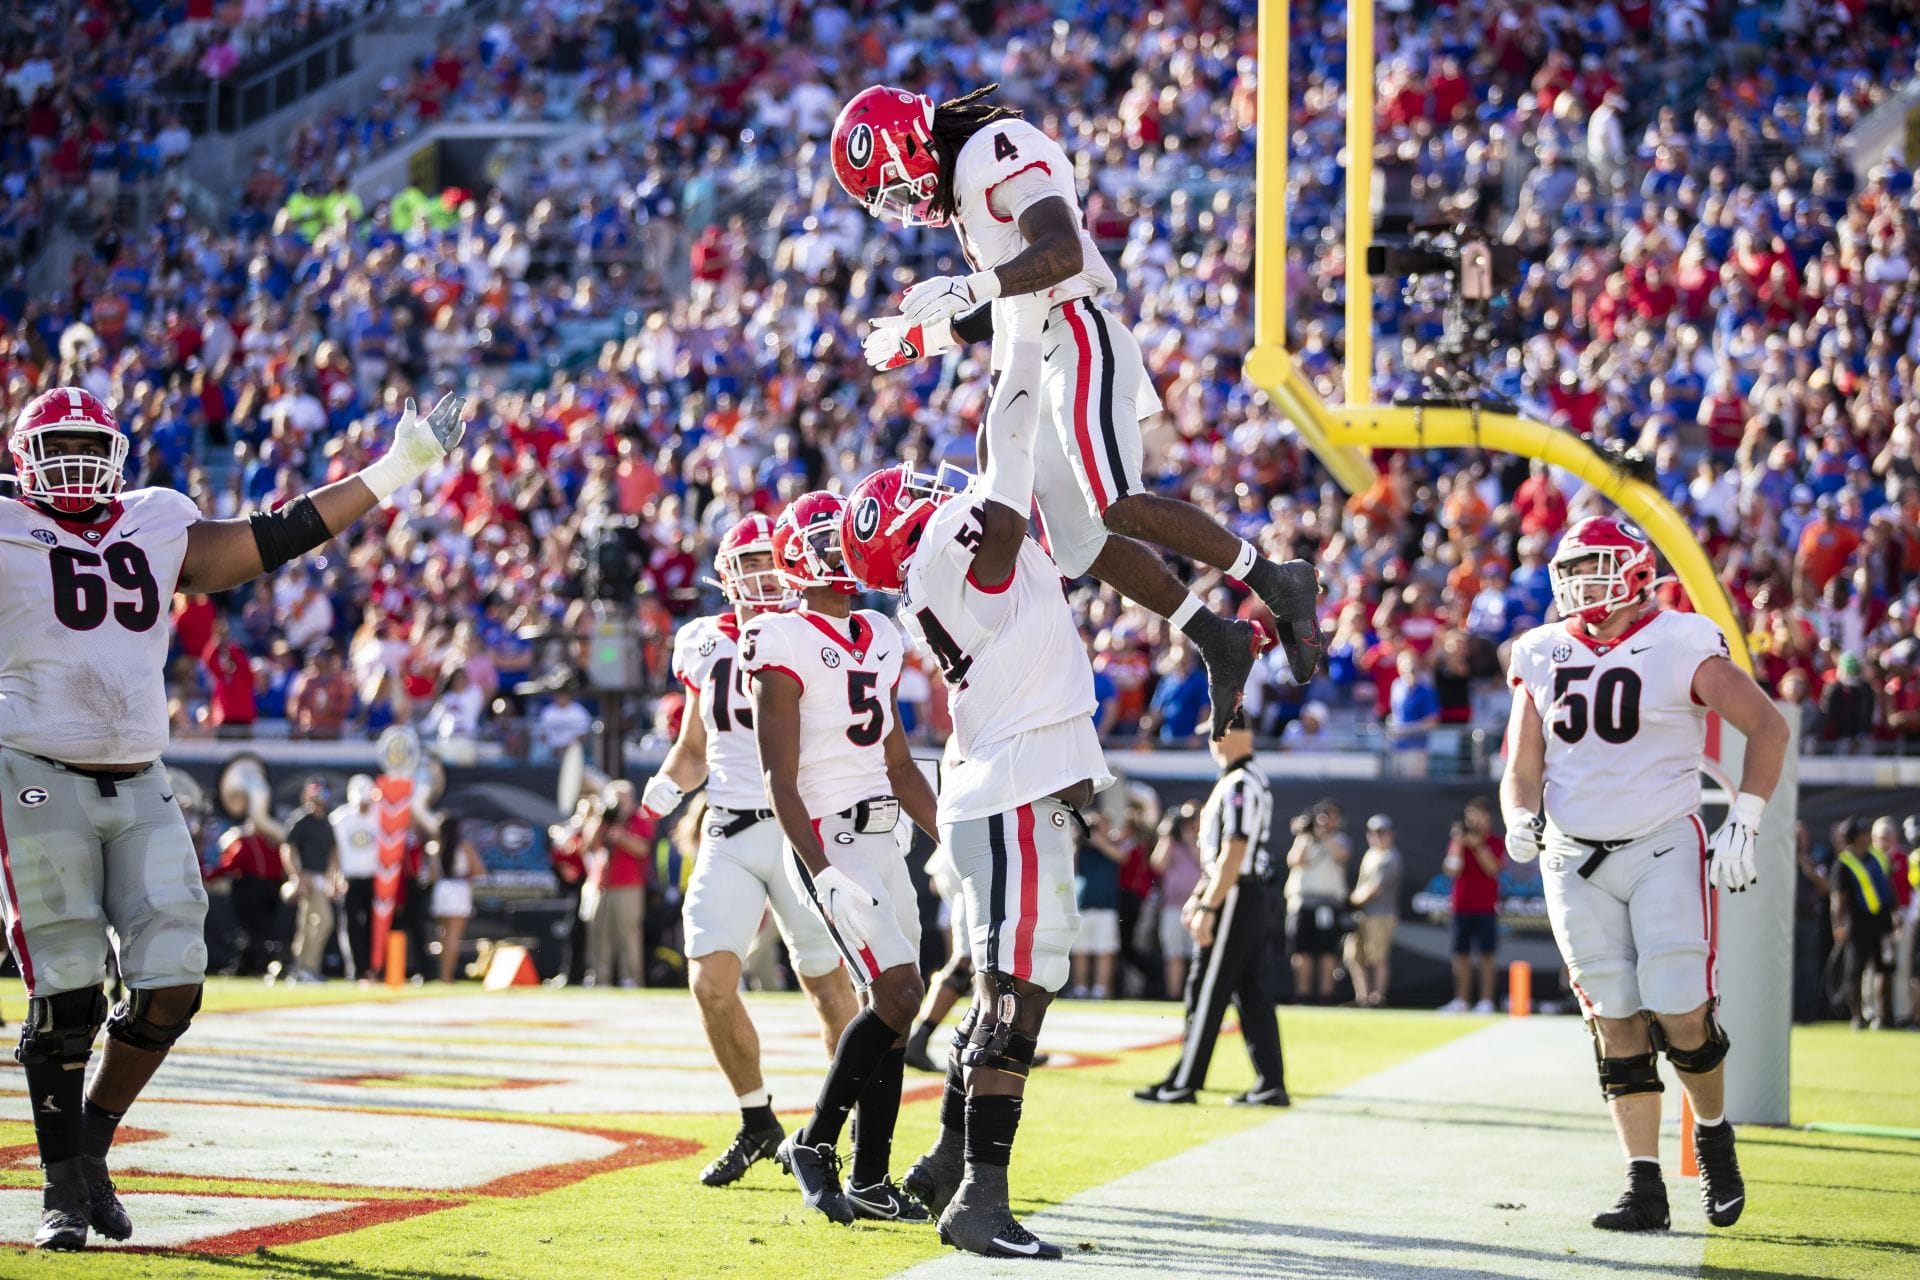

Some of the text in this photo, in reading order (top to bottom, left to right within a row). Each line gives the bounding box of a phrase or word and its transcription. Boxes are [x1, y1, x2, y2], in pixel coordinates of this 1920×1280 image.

[847, 123, 875, 170] G
[993, 132, 1019, 162] 4
[853, 496, 881, 543] G
[49, 541, 160, 633] 69
[743, 629, 761, 661] 5
[846, 669, 884, 747] 5
[1553, 664, 1642, 744] 50
[17, 785, 50, 808] G
[833, 831, 856, 845] G
[1049, 809, 1066, 831] G
